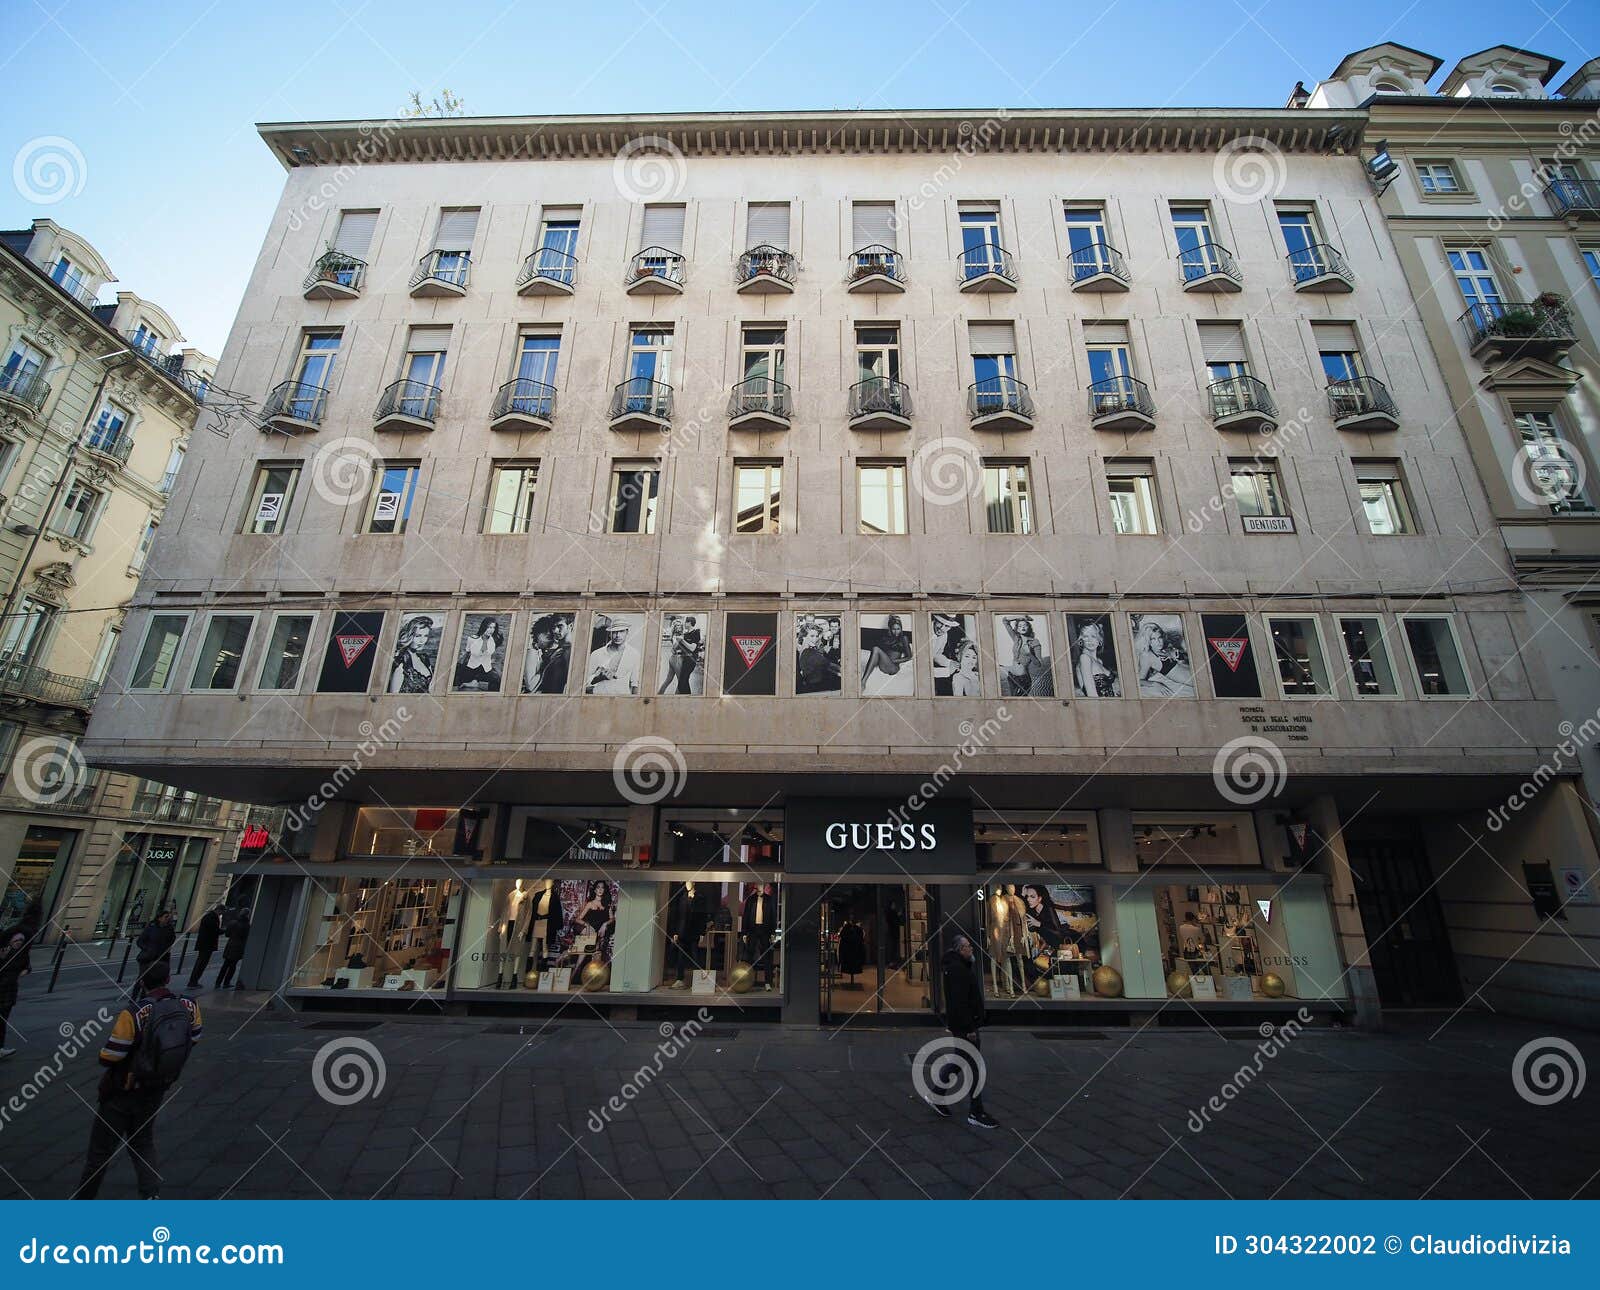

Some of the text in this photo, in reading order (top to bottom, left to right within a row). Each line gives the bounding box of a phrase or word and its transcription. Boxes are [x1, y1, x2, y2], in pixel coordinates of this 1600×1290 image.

[1249, 519, 1288, 530] DENTISTA
[825, 822, 937, 850] GUESS
[471, 952, 514, 962] GUESS
[1263, 956, 1309, 967] GUESS
